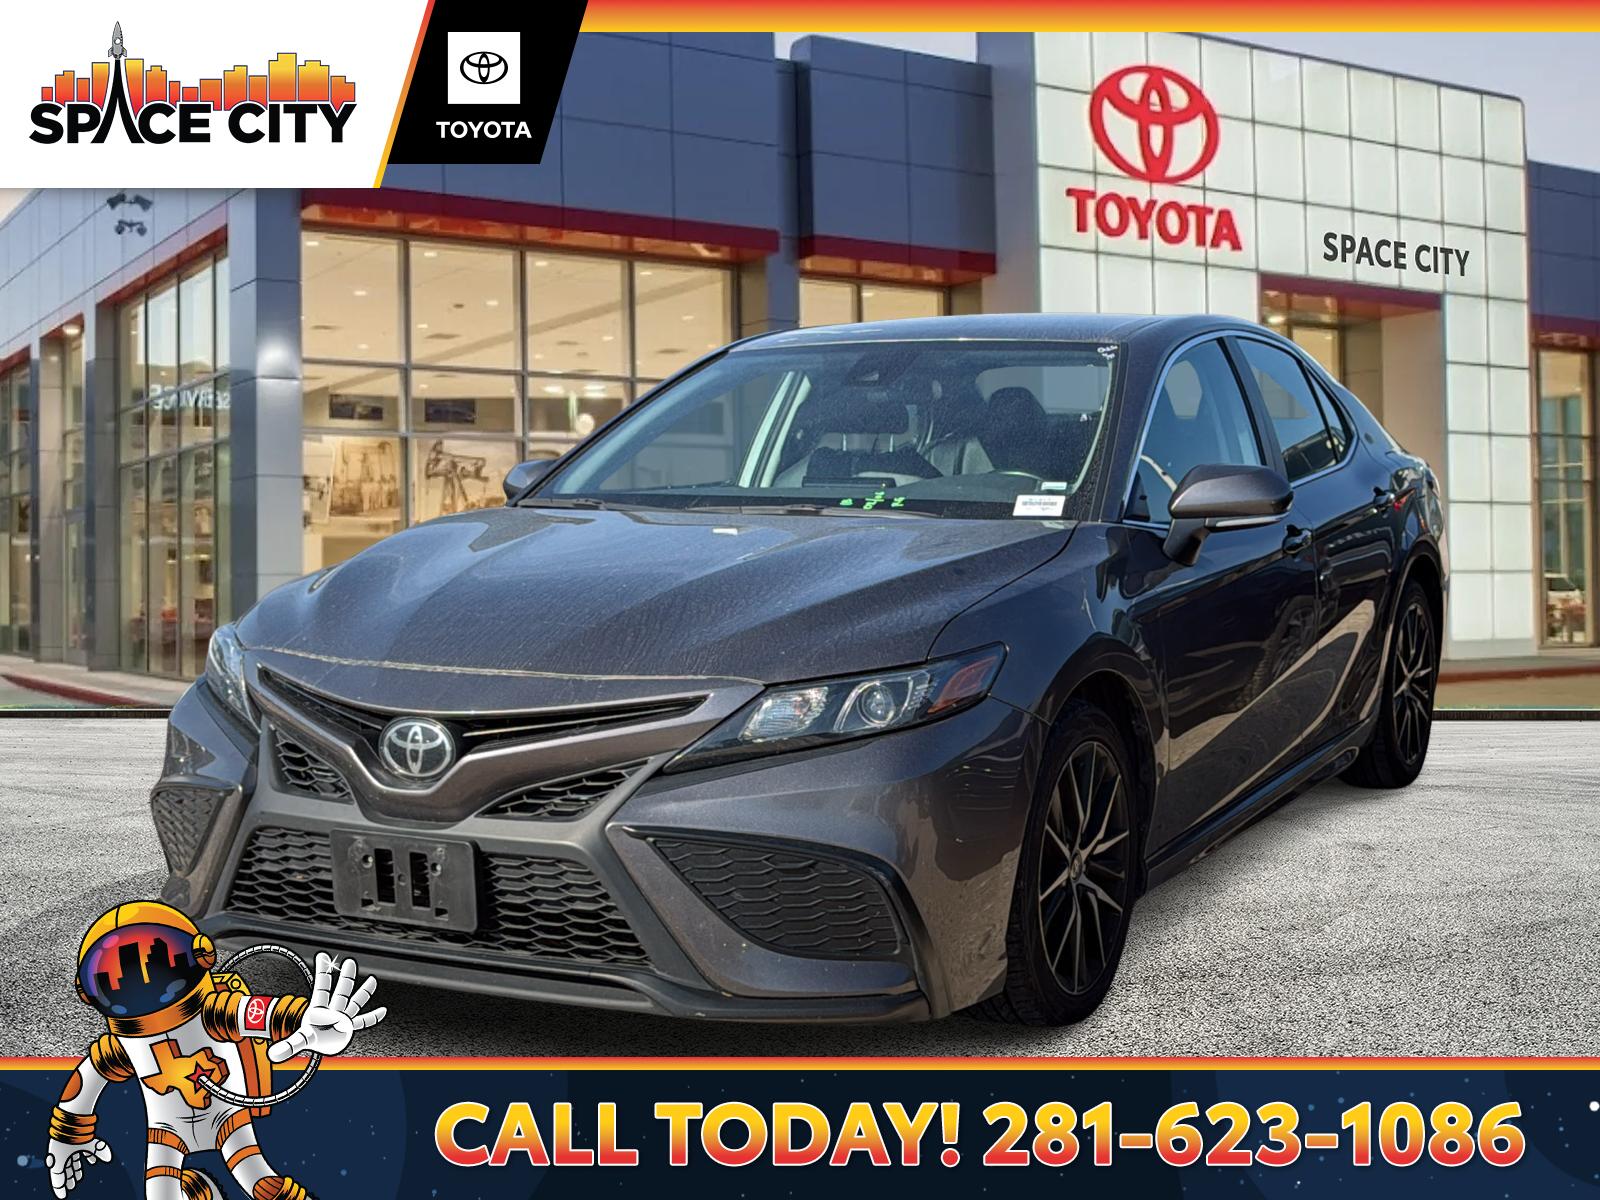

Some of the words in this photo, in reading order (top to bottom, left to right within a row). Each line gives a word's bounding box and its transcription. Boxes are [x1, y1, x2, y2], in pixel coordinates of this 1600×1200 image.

[1065, 187, 1243, 252] TOYOTA
[1322, 231, 1407, 270] SPACE
[1414, 243, 1471, 277] CITY
